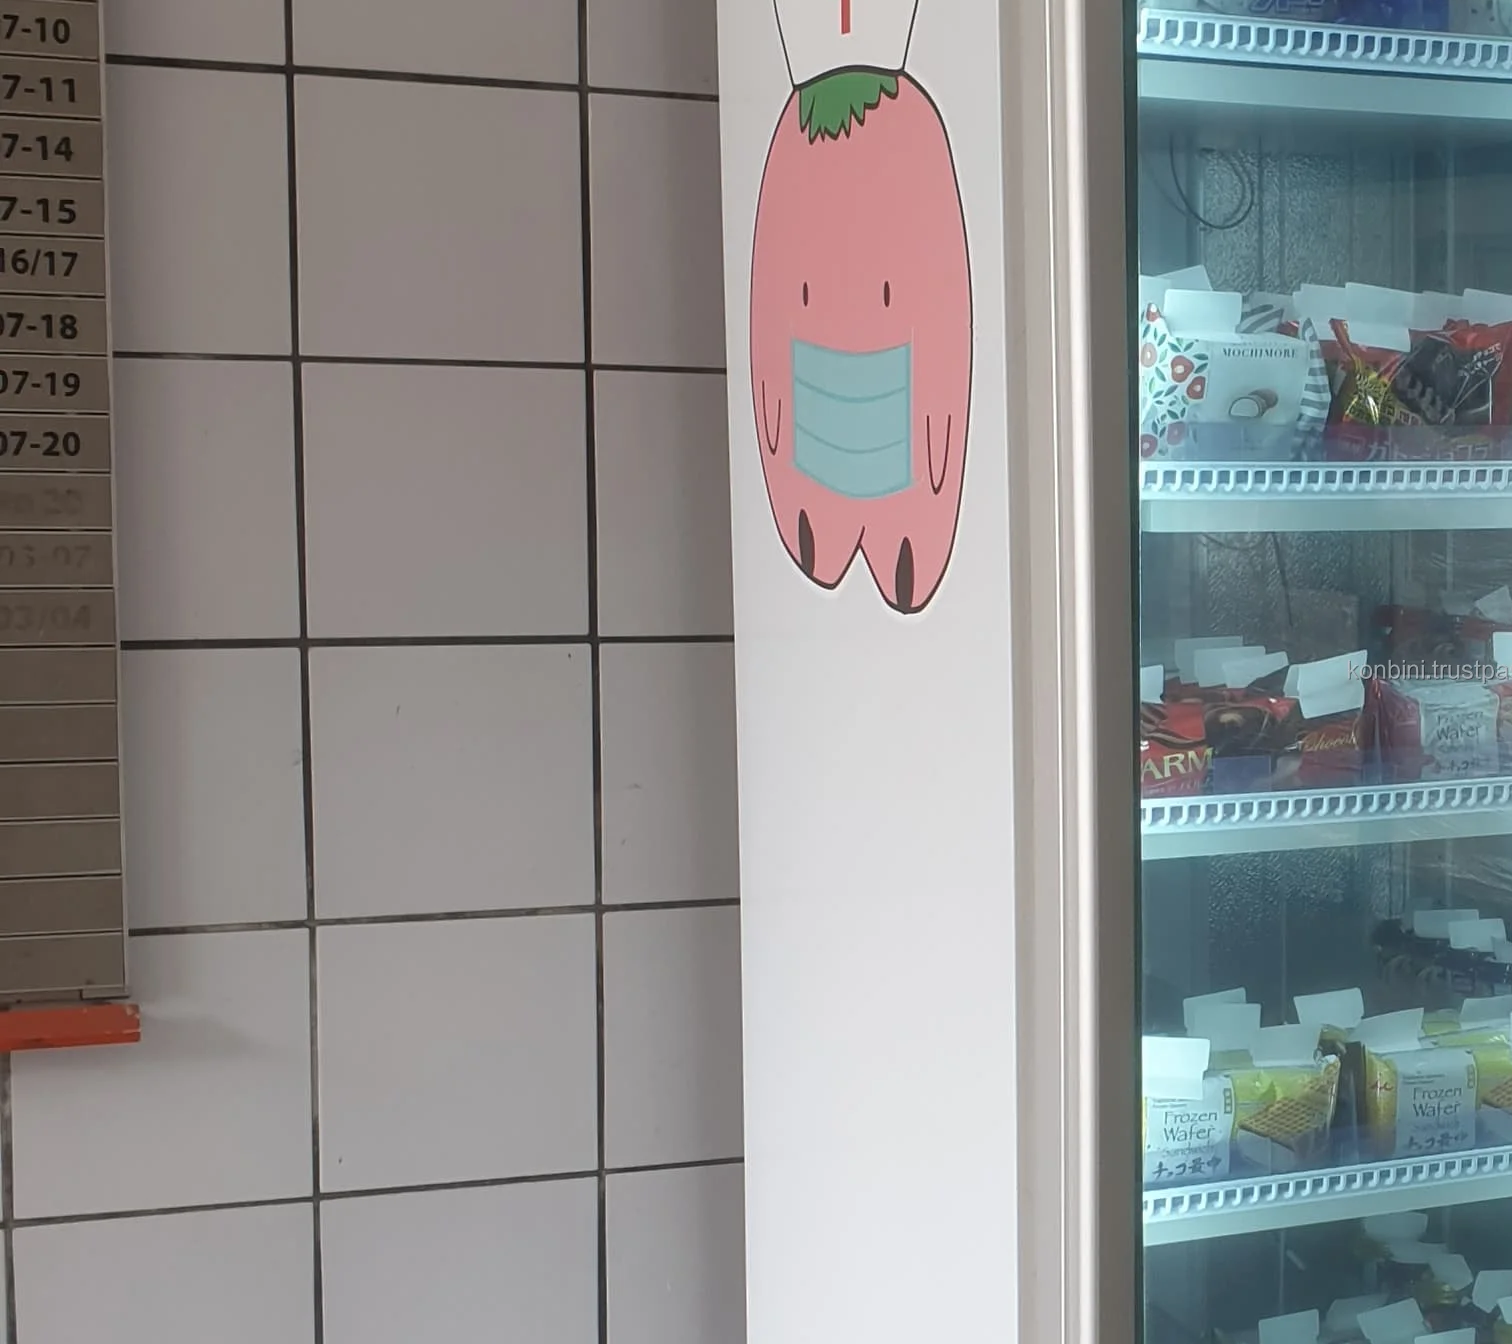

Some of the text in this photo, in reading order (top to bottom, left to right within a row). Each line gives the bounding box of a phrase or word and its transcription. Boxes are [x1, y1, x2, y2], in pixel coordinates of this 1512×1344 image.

[0, 311, 79, 341] 7-18
[1413, 1087, 1462, 1100] Frozen
[1412, 1102, 1462, 1117] Wafer
[1164, 1111, 1218, 1124] Frozen
[1163, 1124, 1216, 1143] Wafer
